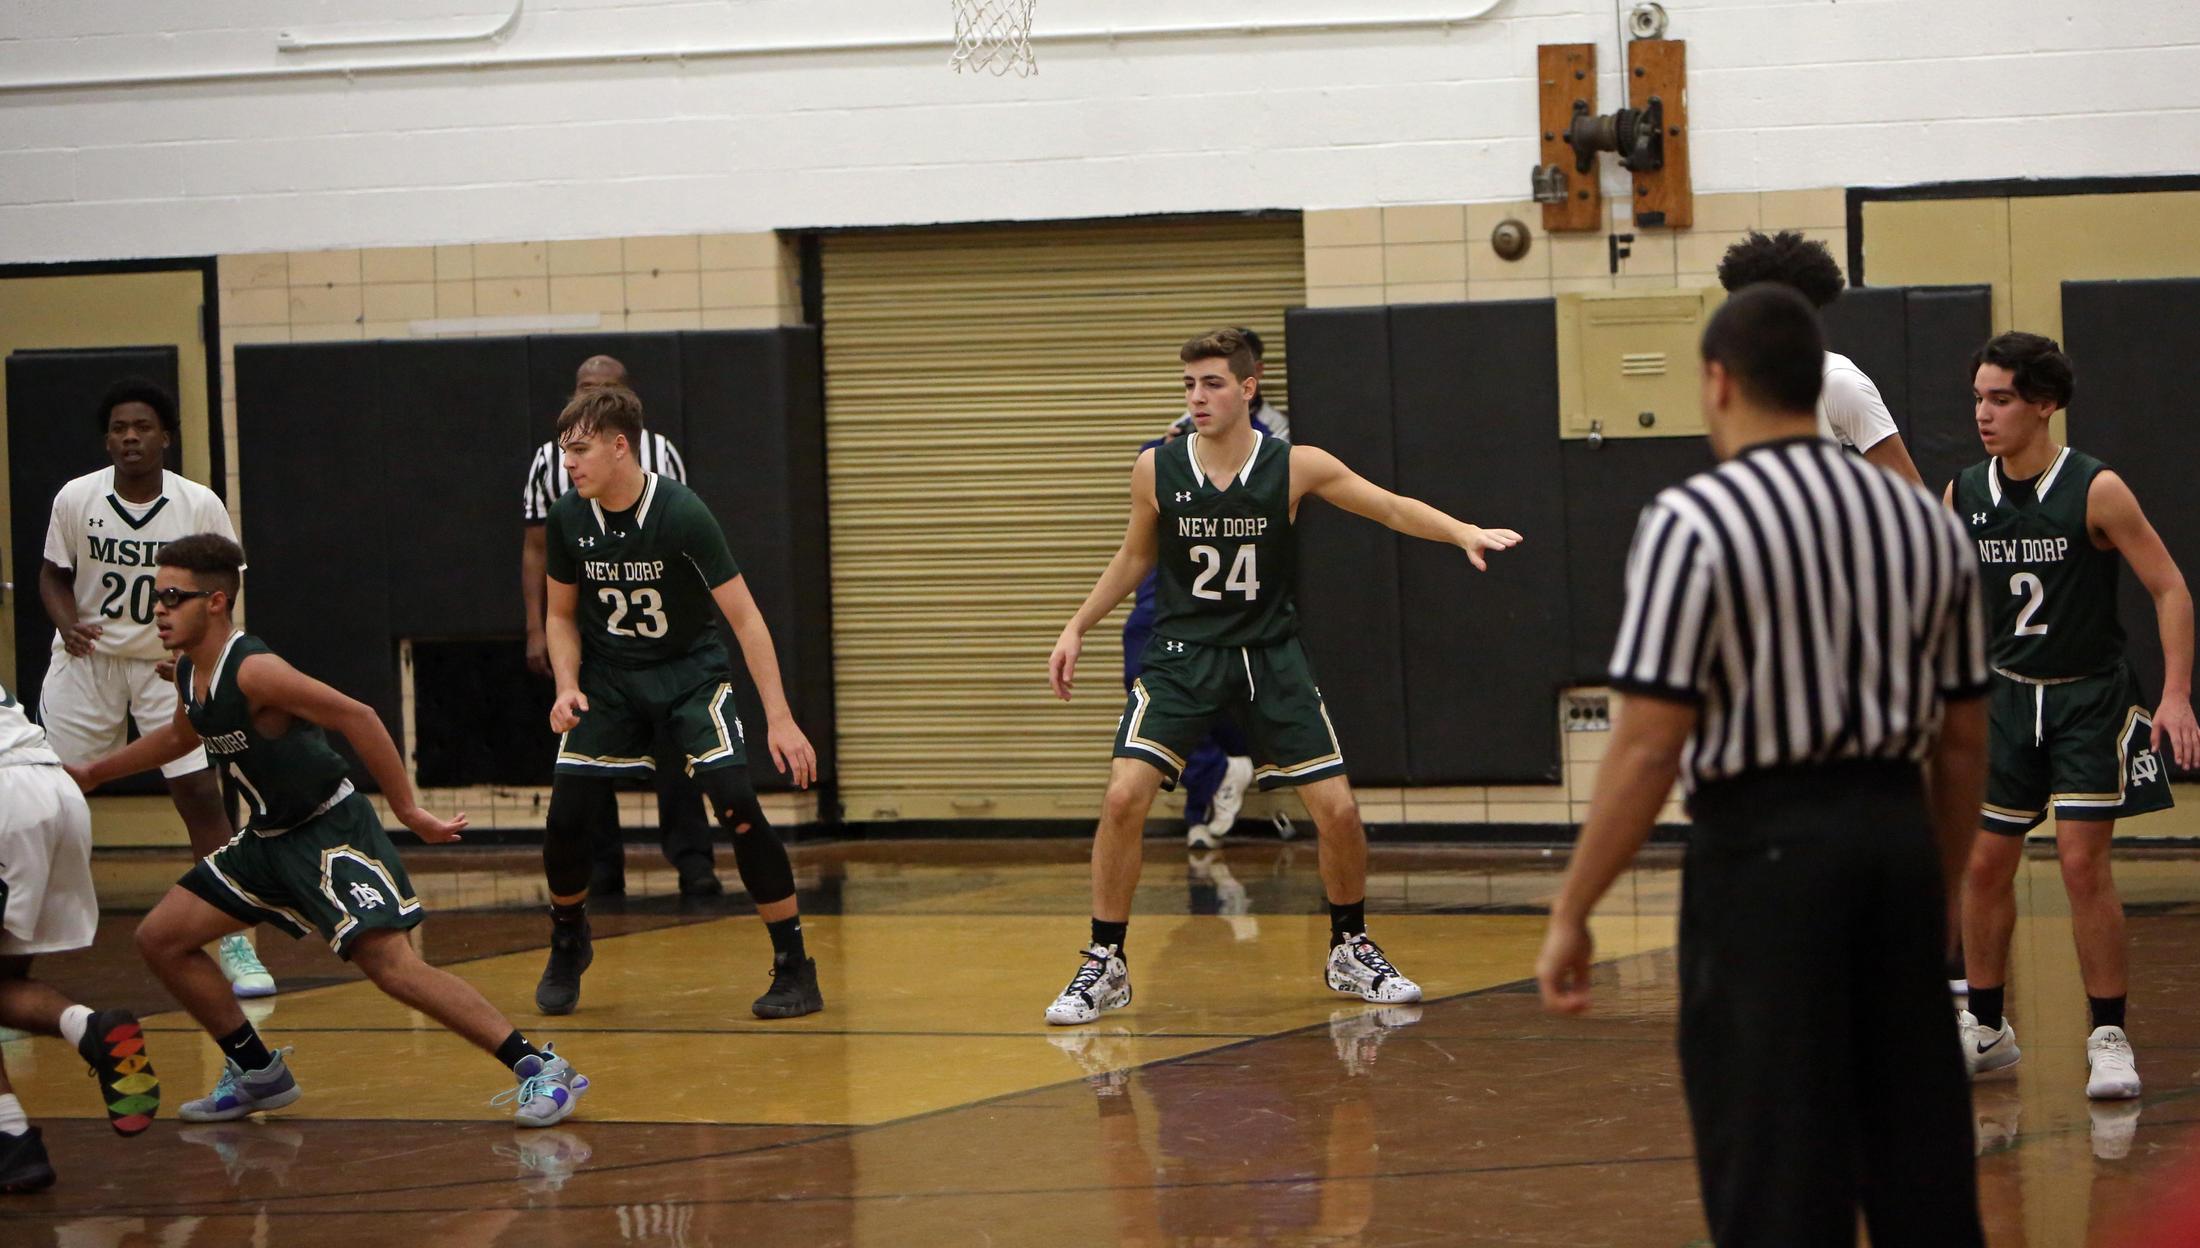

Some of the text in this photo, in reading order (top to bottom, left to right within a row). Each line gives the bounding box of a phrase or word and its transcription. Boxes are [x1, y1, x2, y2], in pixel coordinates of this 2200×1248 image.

[87, 535, 172, 567] MSI
[1179, 516, 1267, 538] NEW DORP
[1978, 537, 2068, 563] NEW DORP
[585, 560, 664, 581] NEW DORP
[1189, 543, 1260, 600] 24
[100, 571, 156, 624] 20
[598, 587, 668, 638] 23
[2009, 572, 2048, 636] 2
[229, 761, 266, 815] 1
